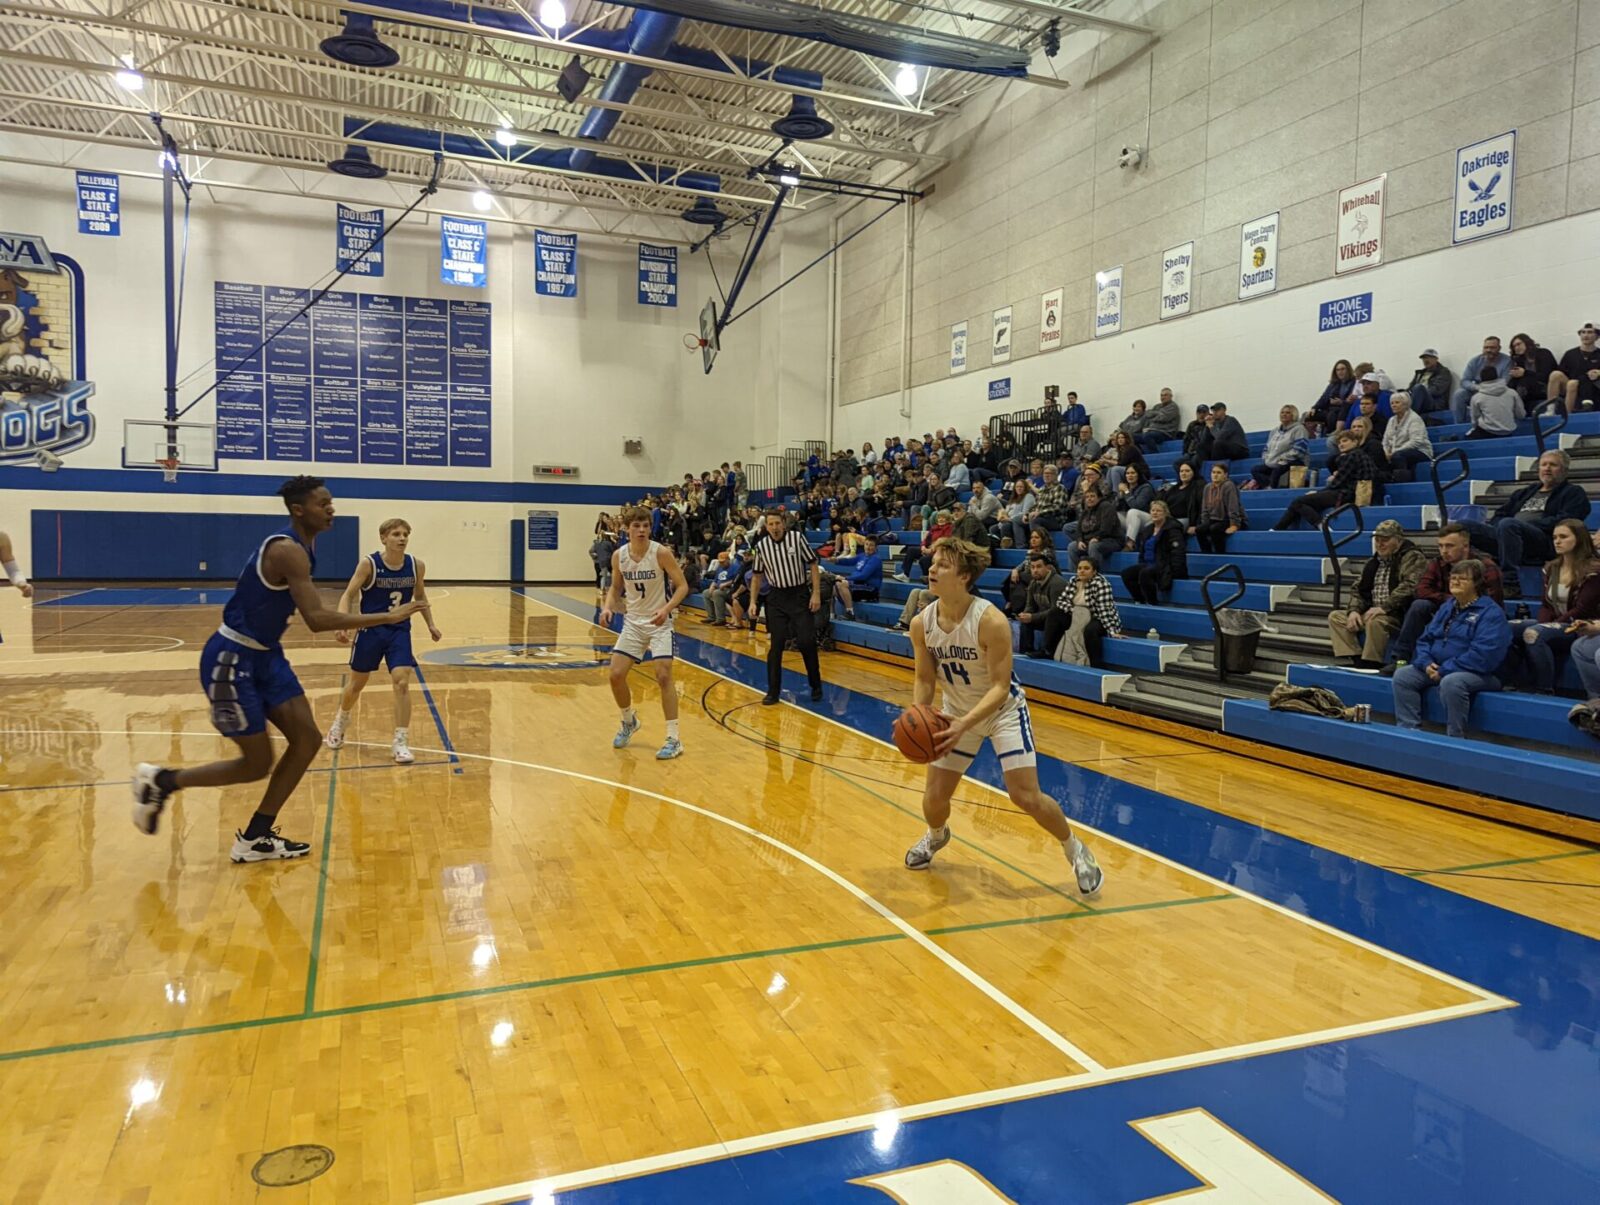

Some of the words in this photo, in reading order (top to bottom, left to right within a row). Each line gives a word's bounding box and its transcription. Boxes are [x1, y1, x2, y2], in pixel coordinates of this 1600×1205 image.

[1461, 150, 1510, 178] Oakridge
[78, 175, 118, 187] VOLLEYBALL
[81, 190, 106, 201] CLASS
[109, 193, 116, 203] C
[1342, 190, 1380, 216] Whitehall
[86, 201, 112, 212] STATE
[339, 208, 381, 223] FOOTBALL
[1459, 201, 1506, 229] Eagles
[343, 225, 369, 239] CLASS
[370, 229, 377, 240] C
[443, 220, 485, 235] FOOTBALL
[447, 237, 473, 251] CLASS
[473, 240, 480, 252] C
[537, 234, 575, 246] FOOTBALL
[452, 249, 476, 262] STATE
[541, 249, 564, 262] CLASS
[566, 252, 572, 263] C
[640, 244, 676, 257] FOOTBALL
[1340, 238, 1378, 262] Vikings
[545, 261, 567, 273] STATE
[1164, 255, 1191, 272] Shelby
[537, 270, 575, 284] CHAMPION
[648, 271, 668, 283] STATE
[1241, 268, 1274, 289] Spartans
[224, 284, 254, 292] Baseball
[546, 282, 565, 294] 1997
[640, 281, 676, 295] CHAMPION
[318, 299, 352, 307] Basketball
[647, 292, 668, 304] 2003
[1163, 292, 1189, 310] Tigers
[368, 303, 394, 311] Bowling
[414, 306, 439, 314] Bowling
[1328, 296, 1362, 316] HOME
[1097, 312, 1119, 328] Bulldogs
[1321, 308, 1369, 330] PARENTS
[412, 384, 442, 392] Volleyball
[456, 386, 486, 394] Wrestling
[622, 570, 656, 580] BULLDOGS
[634, 583, 646, 599] 4
[388, 591, 402, 611] 3
[941, 662, 971, 686] 14
